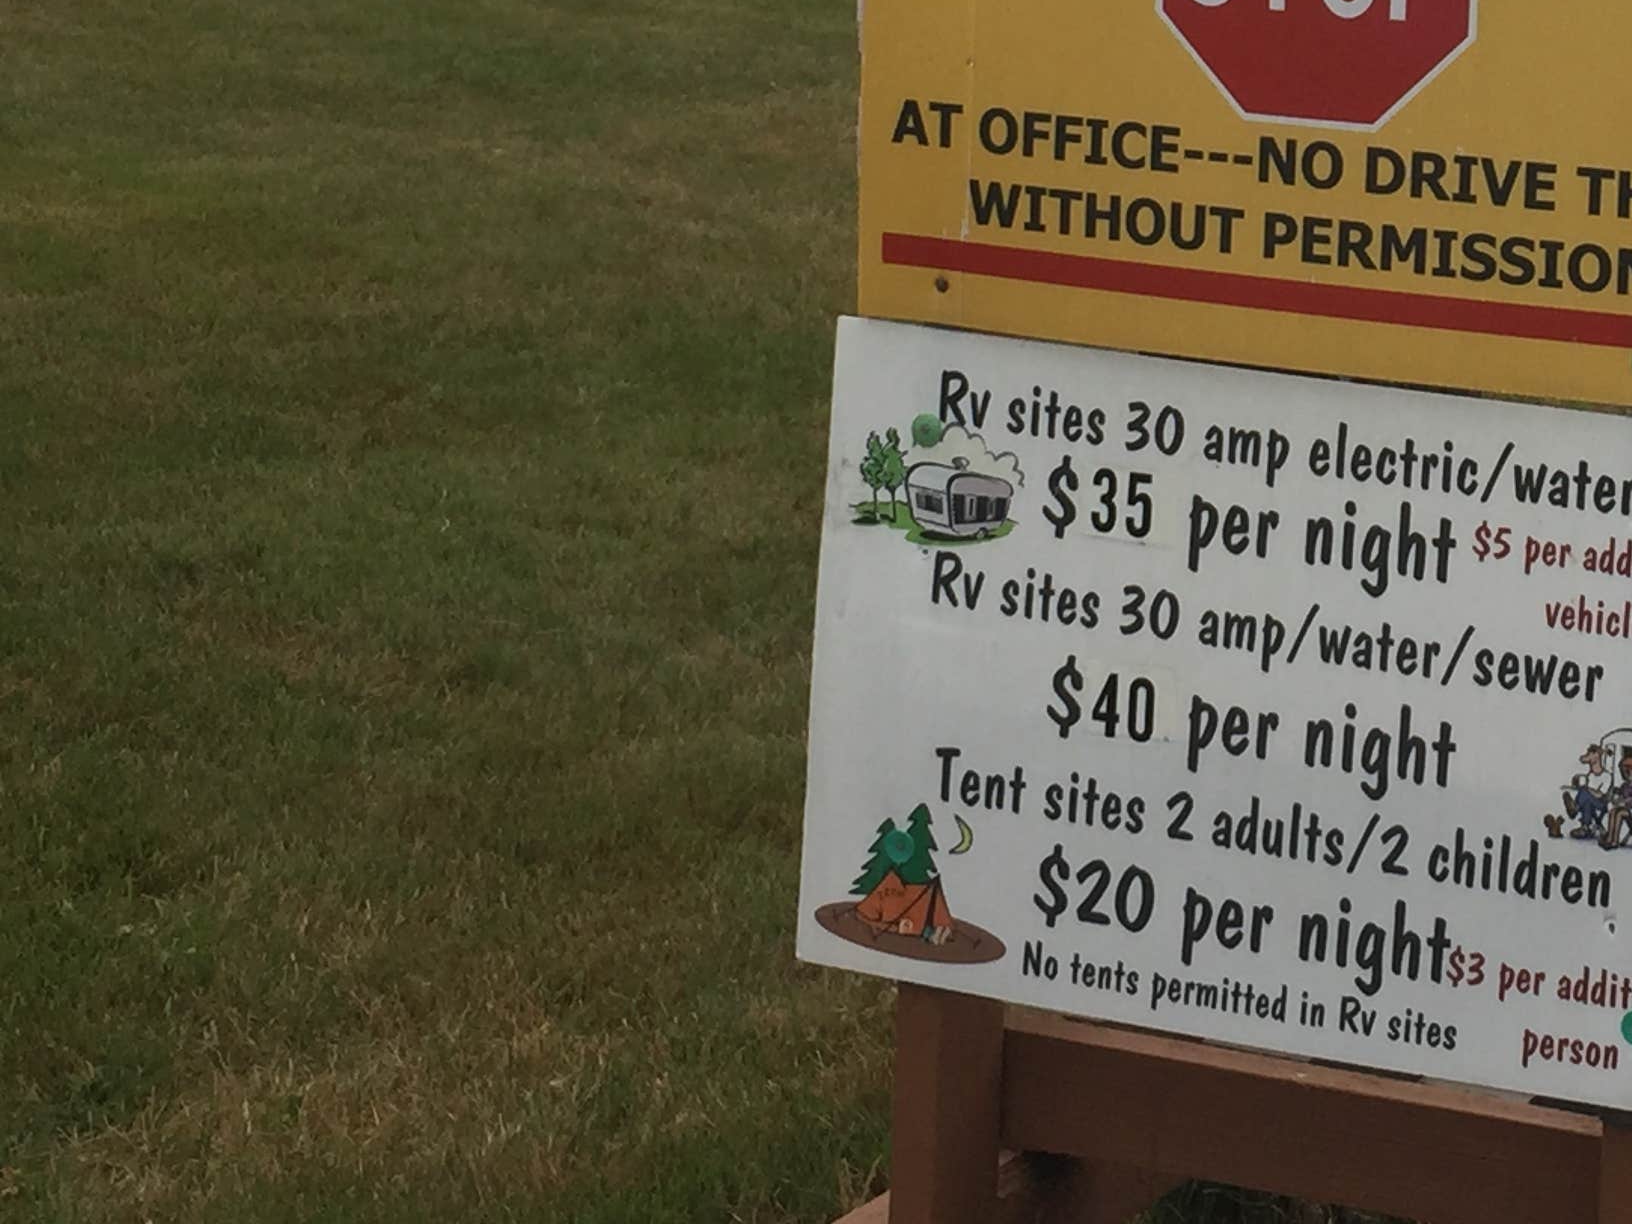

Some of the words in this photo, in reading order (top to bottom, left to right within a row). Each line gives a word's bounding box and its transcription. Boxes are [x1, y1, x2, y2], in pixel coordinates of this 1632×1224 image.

[890, 98, 964, 149] AT
[1364, 146, 1558, 212] DRIVE
[968, 178, 1245, 255] WITHOUT
[938, 370, 992, 430] Rv
[1006, 385, 1106, 446] sites
[1125, 401, 1185, 456] 30
[1203, 425, 1290, 488] amp
[1042, 454, 1153, 540] $35
[1187, 494, 1280, 573] per
[1304, 500, 1457, 599] night
[1472, 520, 1512, 562] $5
[1524, 536, 1572, 576] per
[931, 550, 985, 611] Rv
[999, 567, 1100, 629] sites
[1119, 585, 1180, 641] 30
[1198, 603, 1604, 703] amp/water/sewer
[1046, 654, 1155, 743] $40
[1187, 694, 1280, 774] per
[1304, 703, 1457, 801] night
[935, 747, 1027, 815] Tent
[1043, 771, 1145, 835] sites
[1166, 790, 1194, 842] 2
[1211, 795, 1409, 877] adults/2
[1427, 827, 1611, 909] children
[1033, 843, 1155, 934] $20
[1180, 886, 1274, 967] per
[1298, 897, 1452, 997] night
[1450, 945, 1486, 988] $3
[1498, 962, 1546, 1002] per
[1022, 940, 1059, 981] No
[1069, 953, 1139, 996] tents
[1150, 972, 1288, 1023] permitted
[1299, 990, 1325, 1028] in
[1338, 995, 1377, 1037] Rv
[1387, 1005, 1457, 1051] sites
[1521, 1028, 1619, 1070] person
